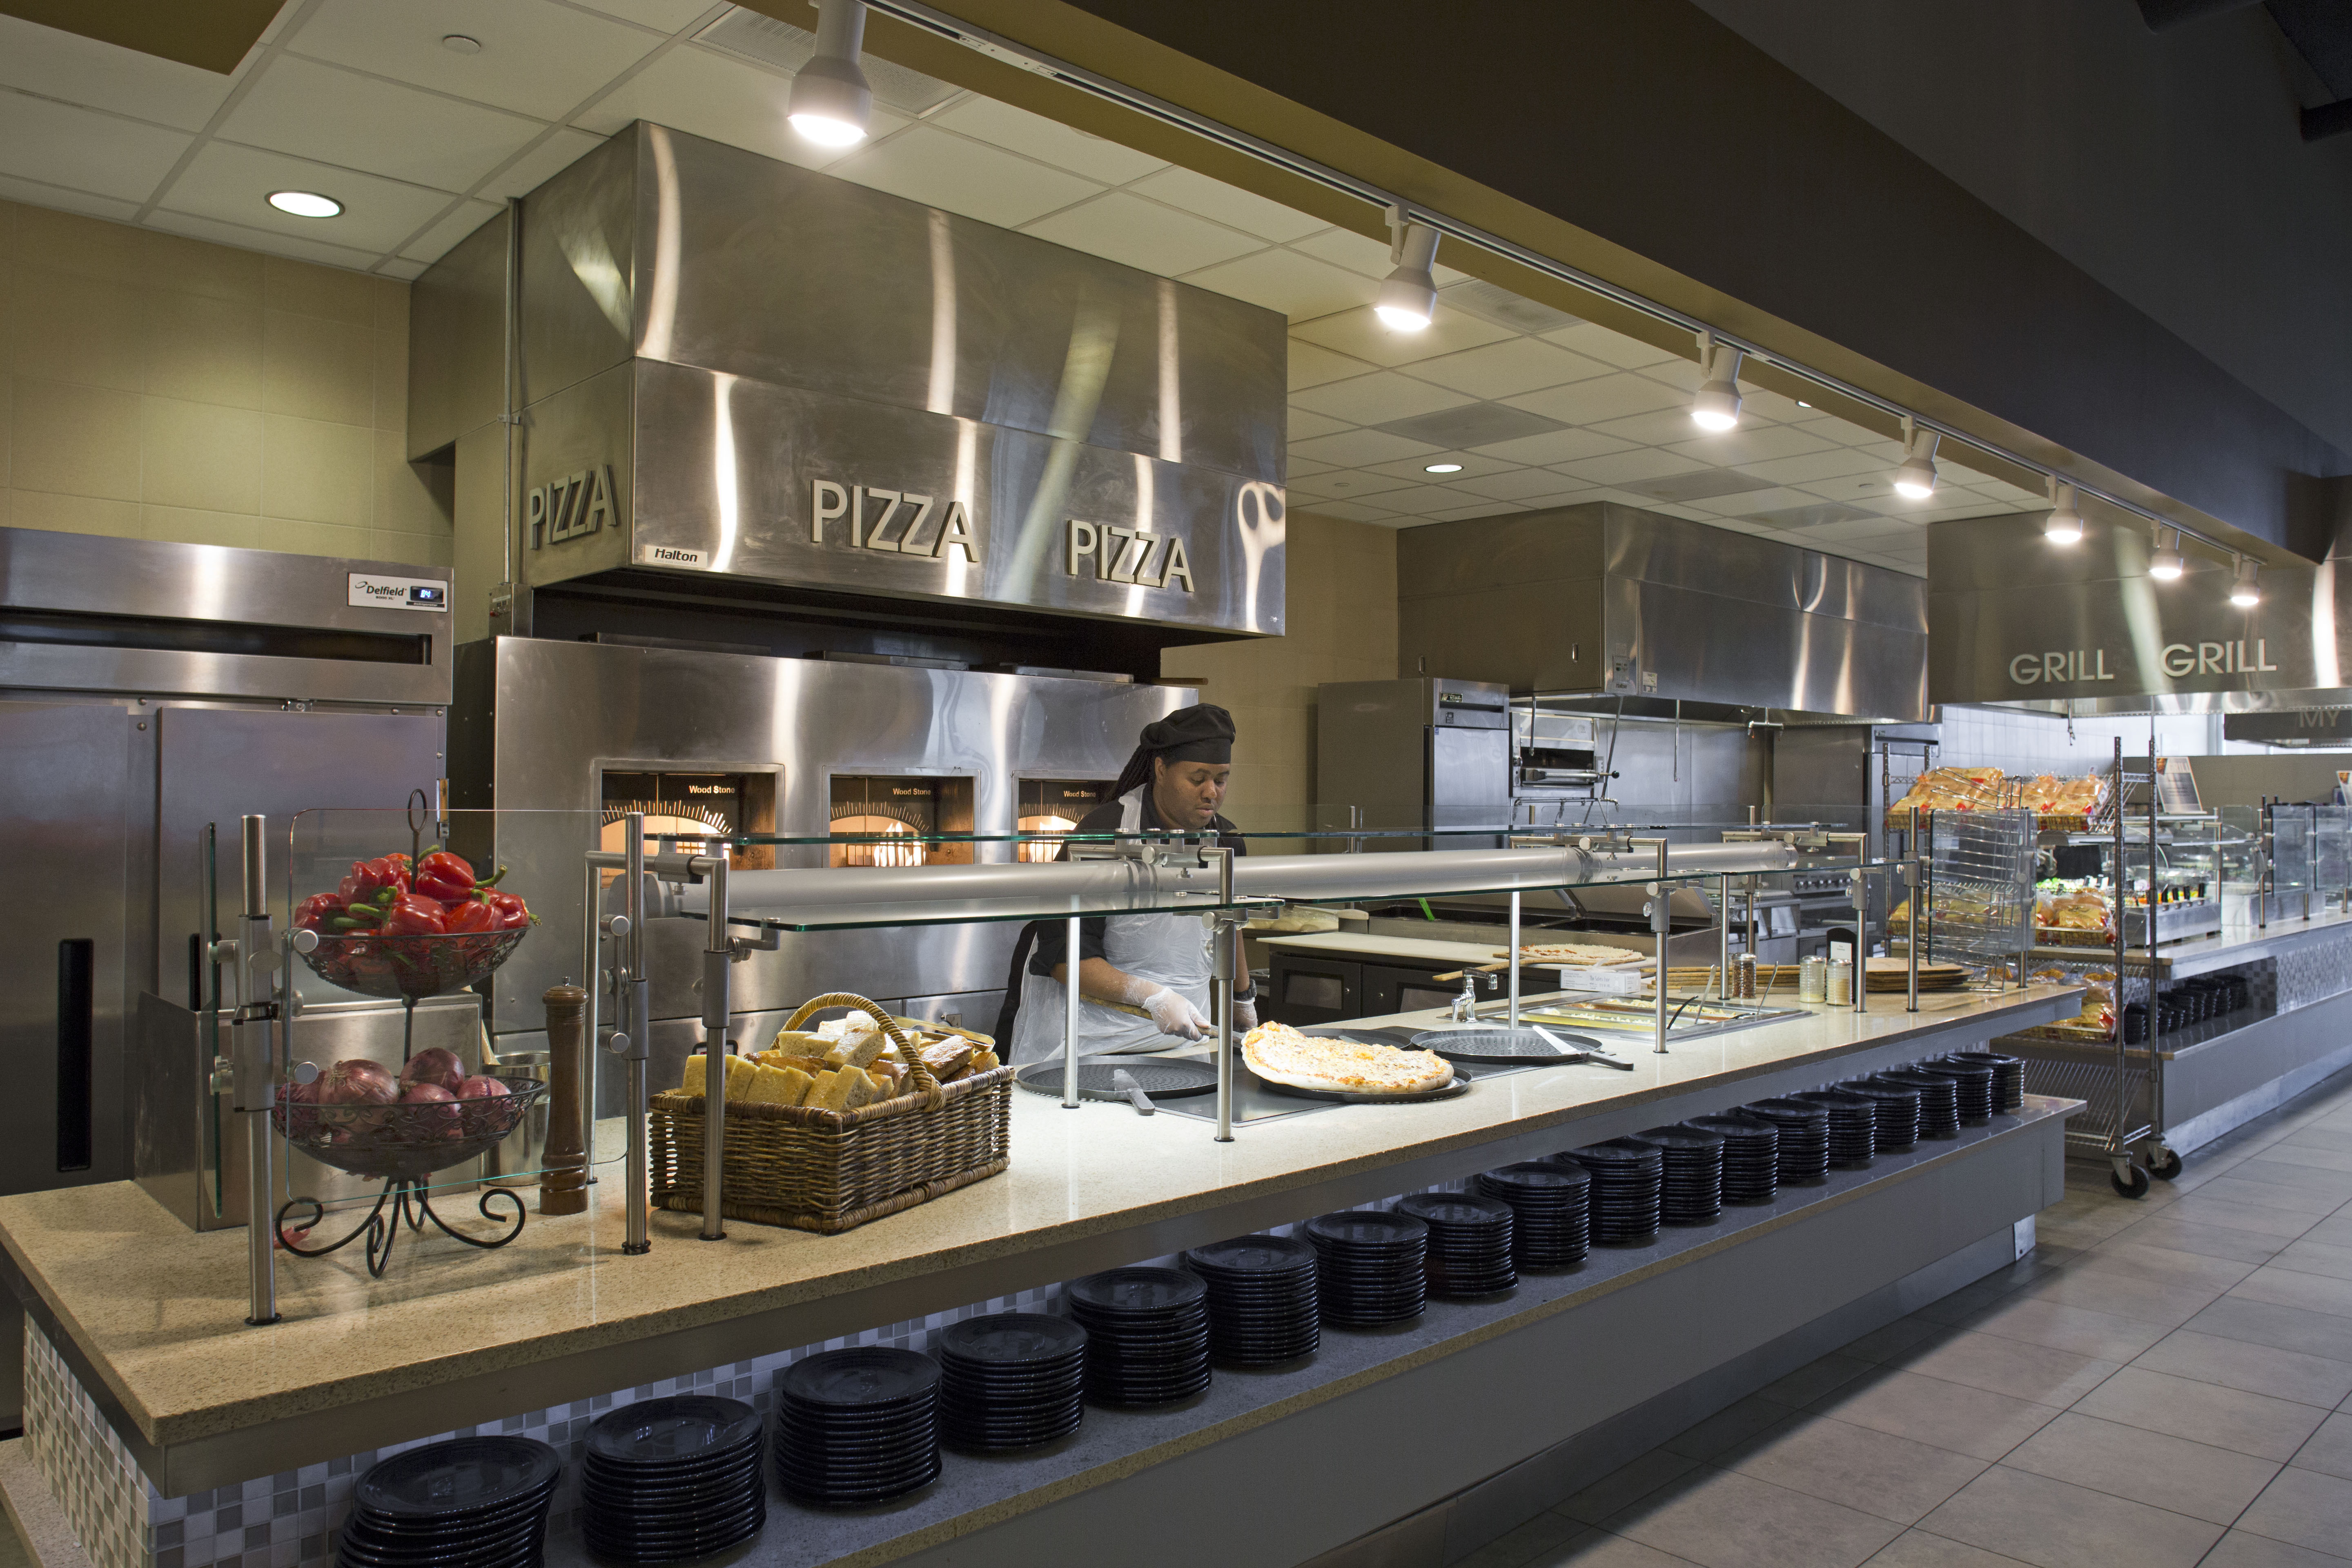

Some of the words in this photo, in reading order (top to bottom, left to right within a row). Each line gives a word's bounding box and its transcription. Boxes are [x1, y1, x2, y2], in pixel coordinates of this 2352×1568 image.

[529, 464, 617, 550] PIZZA
[811, 479, 980, 563] PIZZA
[655, 548, 697, 562] Halton
[1067, 519, 1195, 592] PIZZA
[366, 585, 405, 596] Delfield
[420, 590, 431, 598] 34
[2009, 649, 2114, 685] GRILL
[2160, 639, 2277, 677] GRILL
[2300, 710, 2340, 728] MY
[689, 785, 712, 793] Wood
[713, 785, 735, 793] Stone
